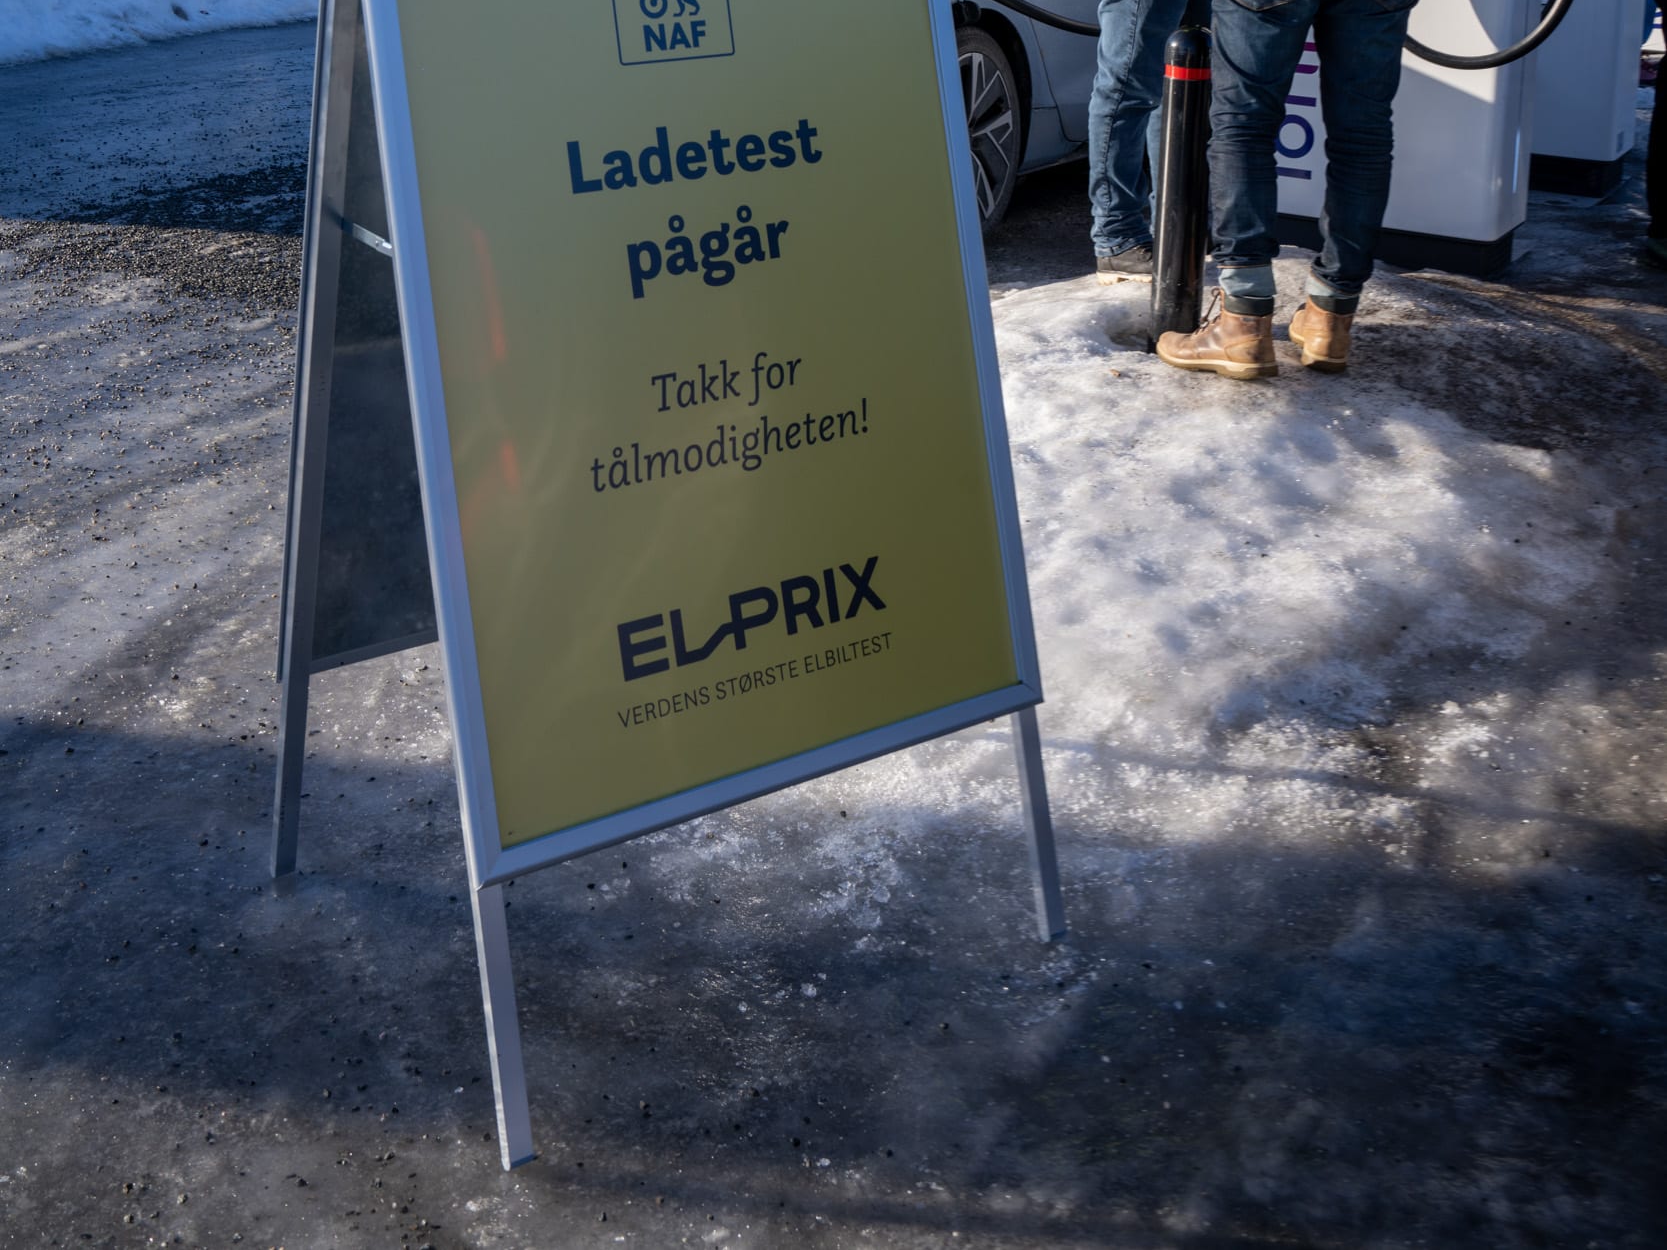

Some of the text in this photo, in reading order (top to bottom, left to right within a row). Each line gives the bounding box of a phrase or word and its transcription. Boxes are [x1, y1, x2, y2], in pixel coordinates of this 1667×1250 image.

[643, 19, 707, 53] NAF
[567, 119, 823, 195] Ladetest
[626, 205, 790, 300] pågår
[650, 351, 803, 413] Takk for
[589, 397, 869, 493] tålmodigheten!
[616, 555, 888, 683] ELPRIX
[617, 631, 893, 728] VERDENS STØRSTE ELBILTEST
